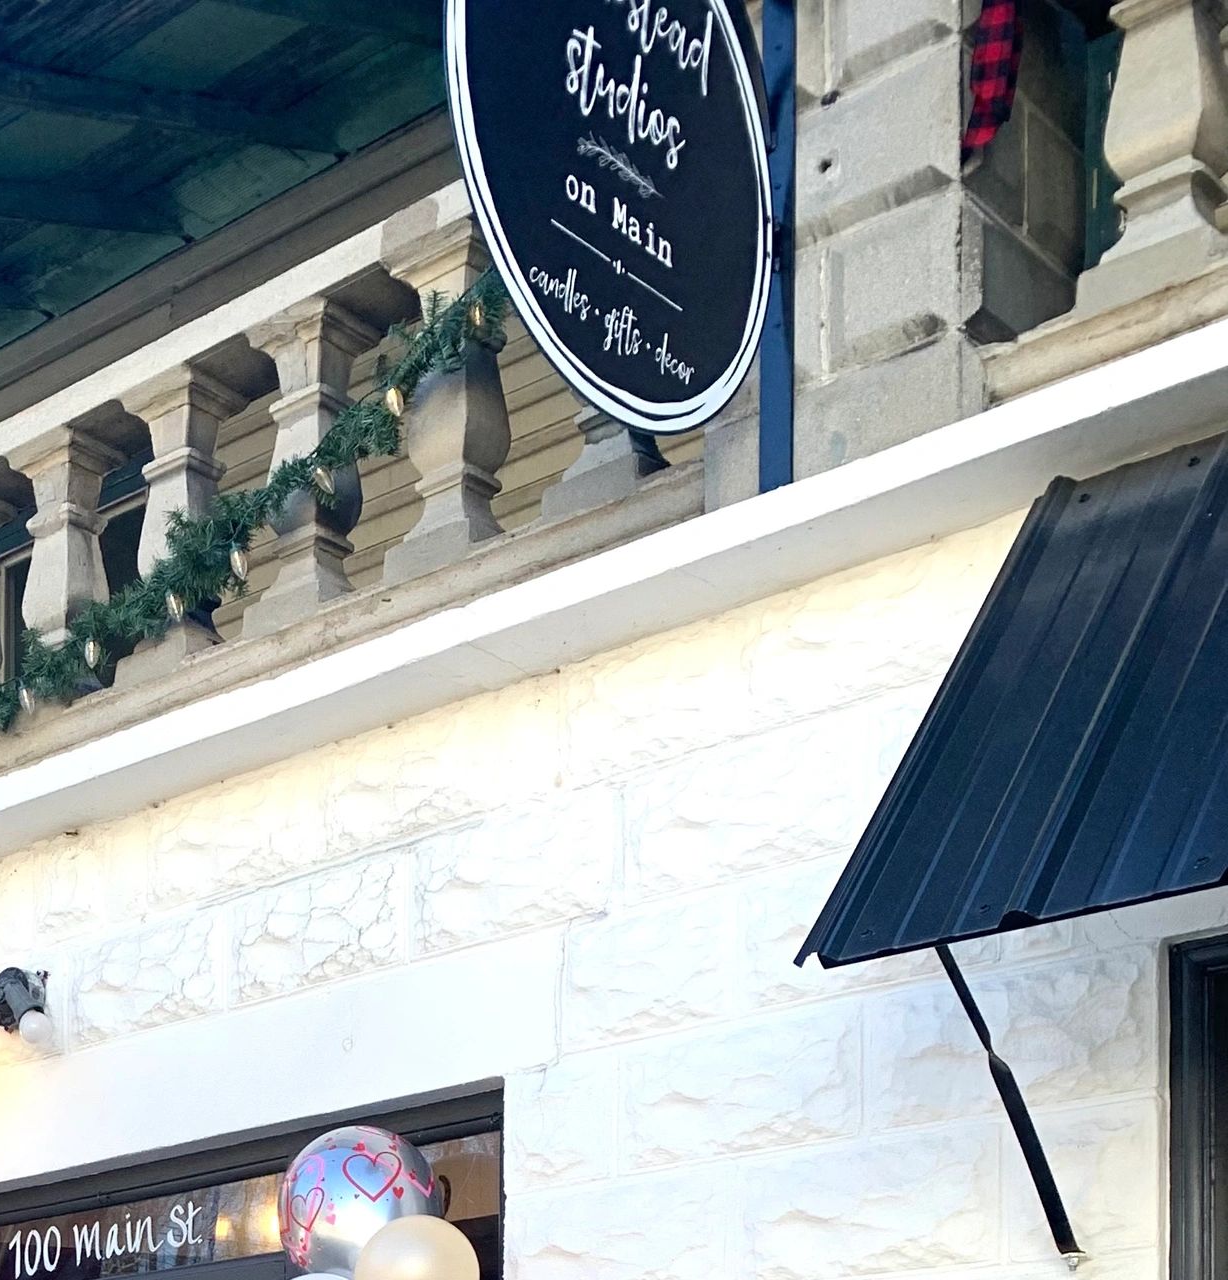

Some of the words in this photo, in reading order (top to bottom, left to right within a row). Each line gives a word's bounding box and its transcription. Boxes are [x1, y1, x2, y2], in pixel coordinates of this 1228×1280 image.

[627, 0, 713, 96] stead
[565, 26, 686, 169] studios
[565, 173, 597, 214] on
[612, 197, 673, 268] Main
[529, 264, 592, 322] candles
[603, 304, 642, 357] gifts
[655, 332, 696, 385] decor
[9, 1225, 61, 1280] 100
[72, 1213, 164, 1267] Main
